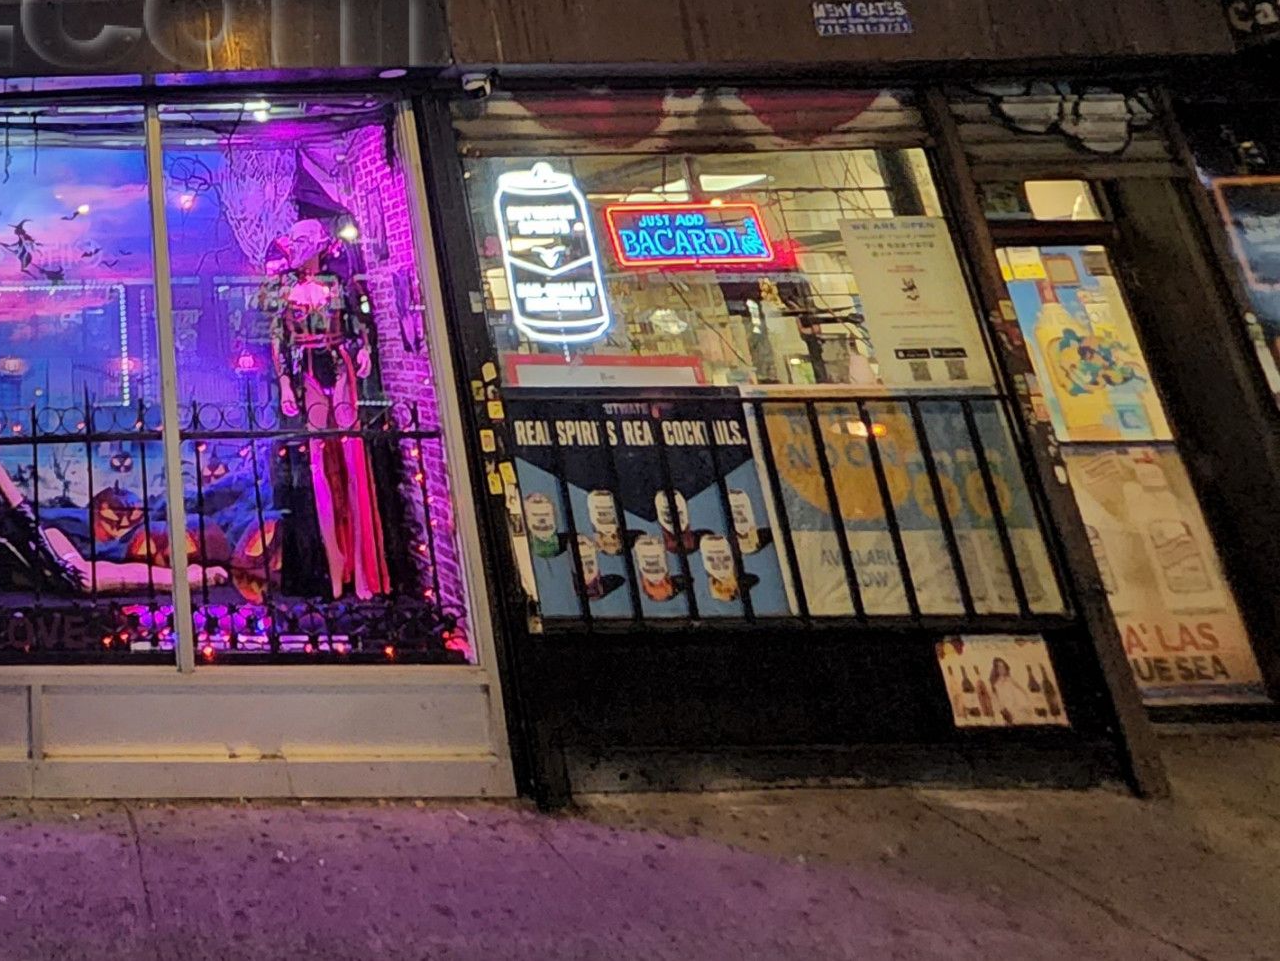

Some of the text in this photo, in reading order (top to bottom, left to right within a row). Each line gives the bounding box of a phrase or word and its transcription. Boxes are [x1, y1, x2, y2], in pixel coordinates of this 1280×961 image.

[638, 213, 705, 228] JUST ADD
[618, 227, 742, 257] BACARDI
[514, 420, 552, 446] REAL
[555, 420, 618, 446] SPIRIS
[622, 420, 656, 446] REA
[1133, 656, 1175, 682] UE
